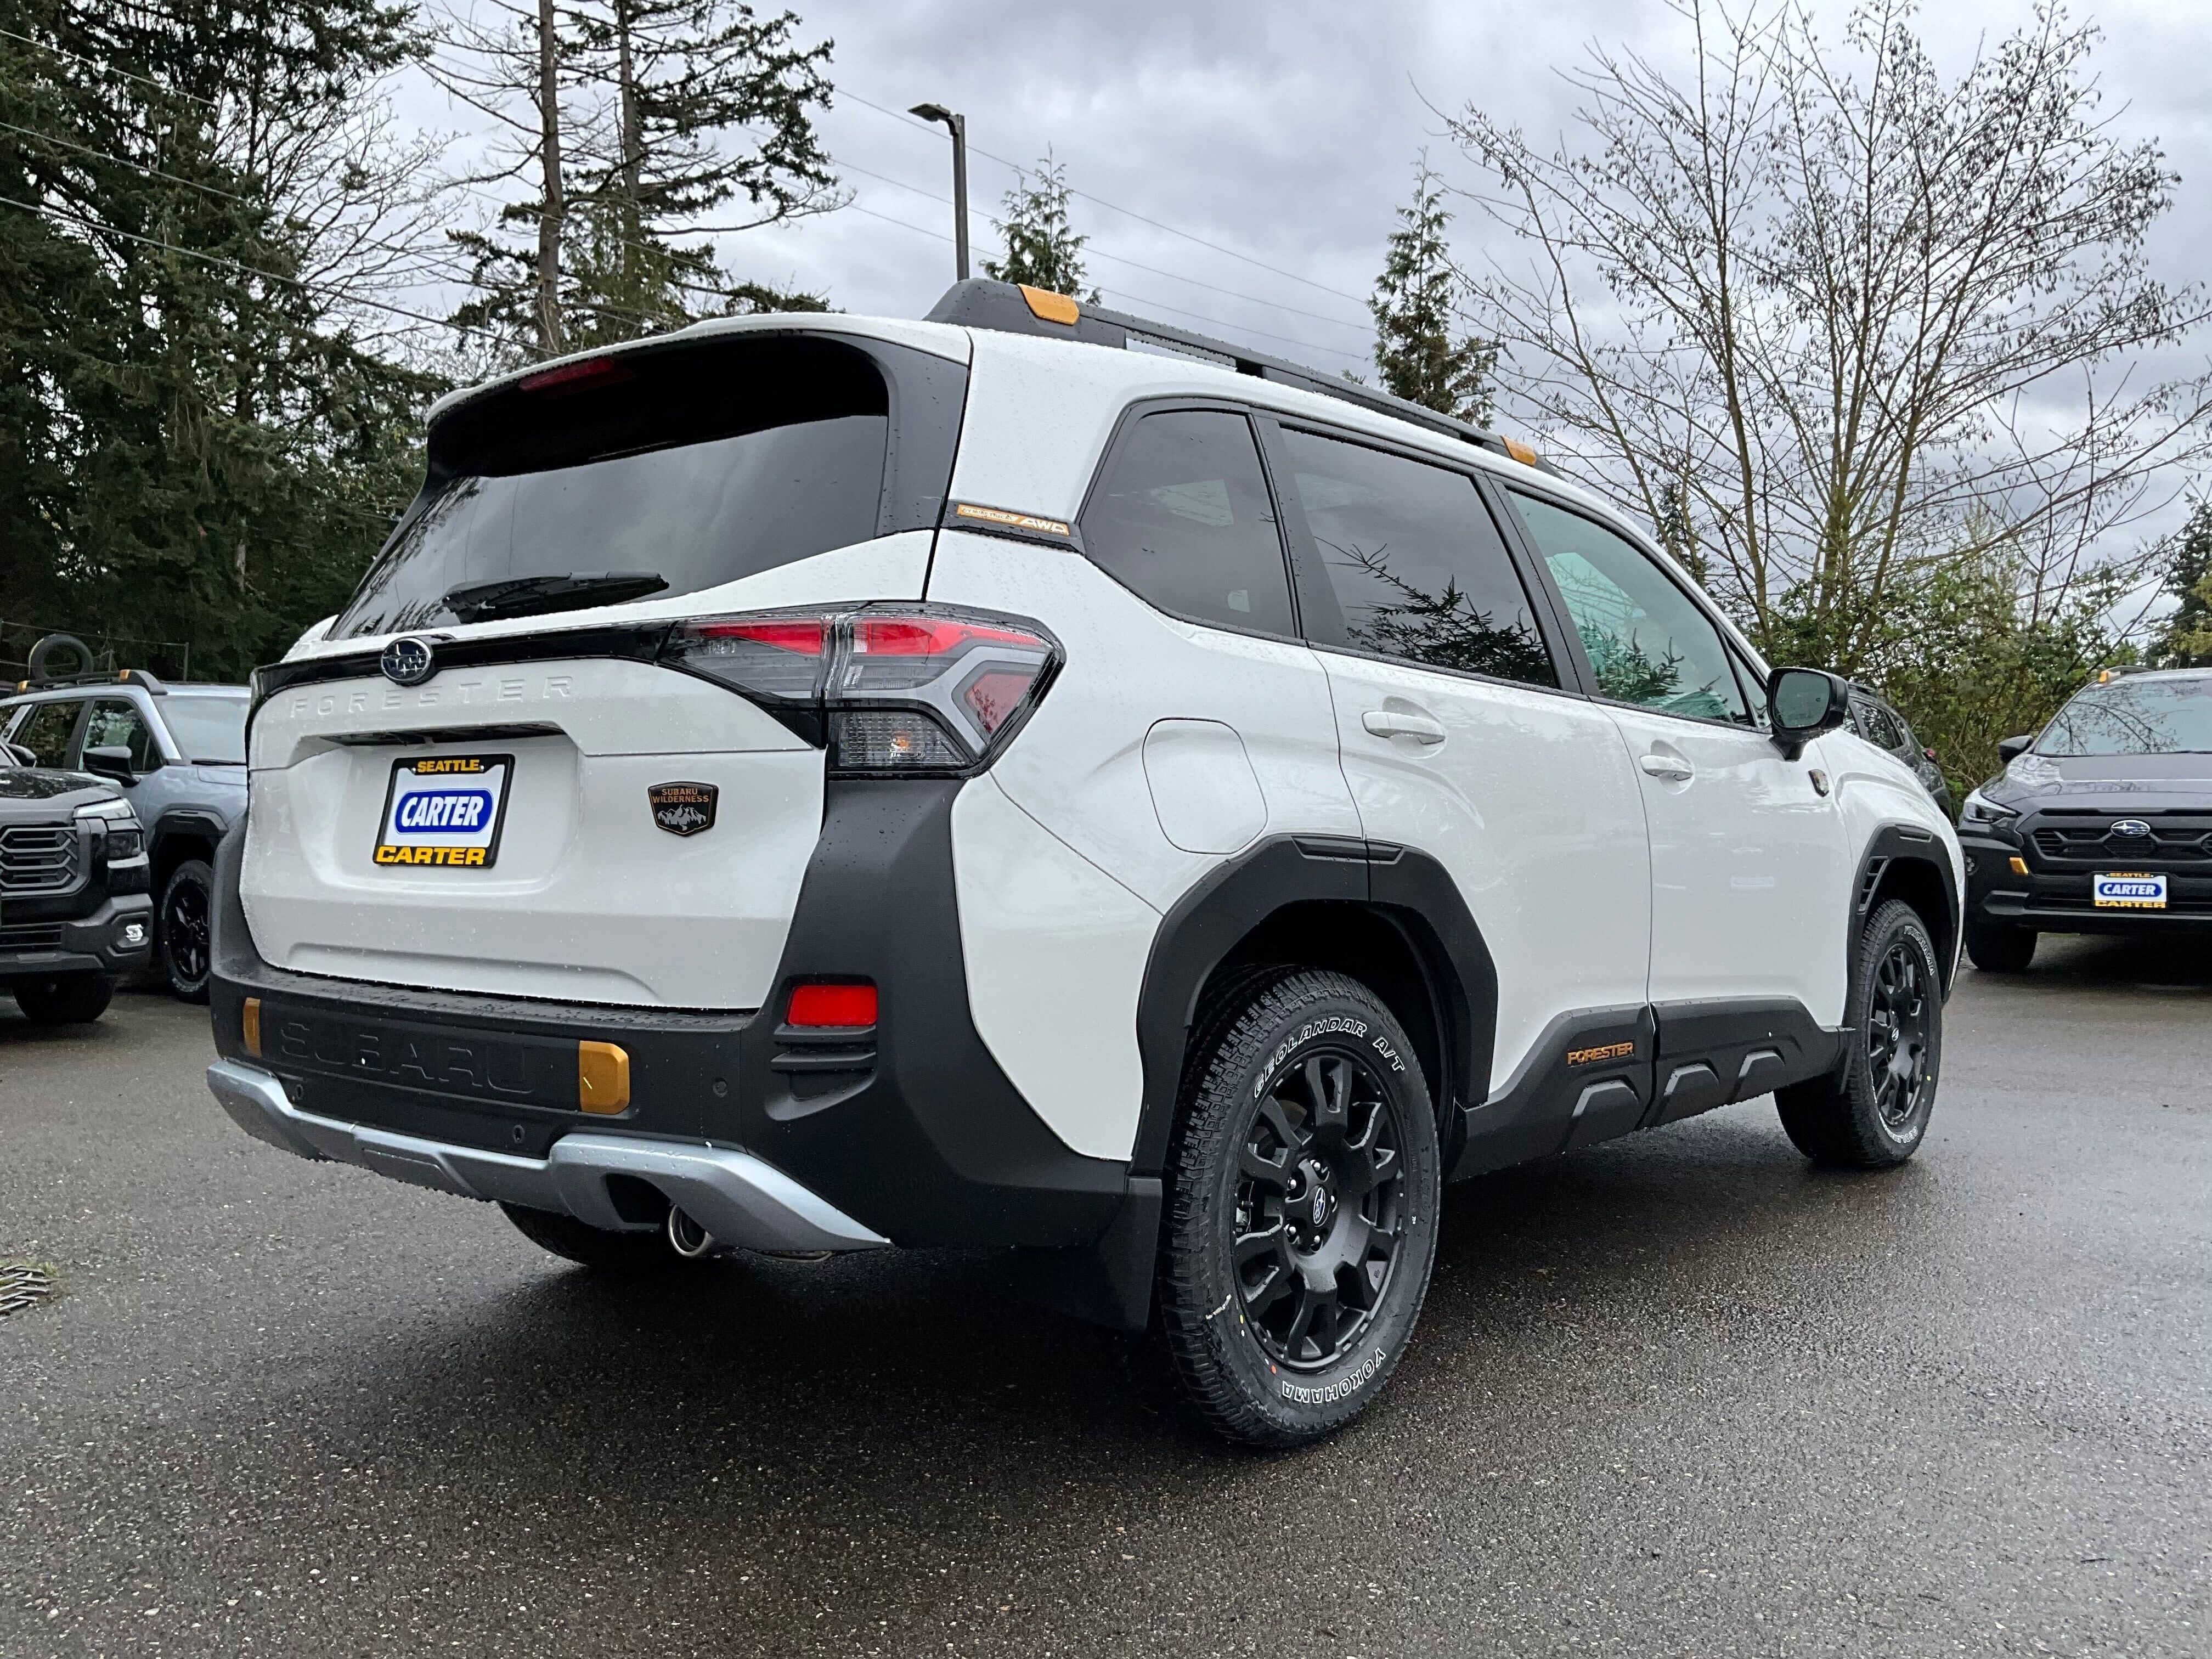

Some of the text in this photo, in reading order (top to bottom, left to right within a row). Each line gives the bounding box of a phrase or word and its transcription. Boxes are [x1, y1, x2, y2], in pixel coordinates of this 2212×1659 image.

[290, 676, 573, 718] FORESTER
[417, 759, 480, 773] SEATTLE
[652, 795, 710, 803] WILDERNESS
[401, 795, 484, 827] CARTER
[376, 846, 486, 865] CARTER
[2103, 884, 2156, 895] CARTER
[2095, 900, 2166, 909] CARTER
[280, 1022, 535, 1094] SUBARU
[1254, 1017, 1406, 1098] GEOLANDAR A/T
[1567, 1042, 1634, 1065] FORESTER
[1282, 1347, 1386, 1404] YOKOHAMA
